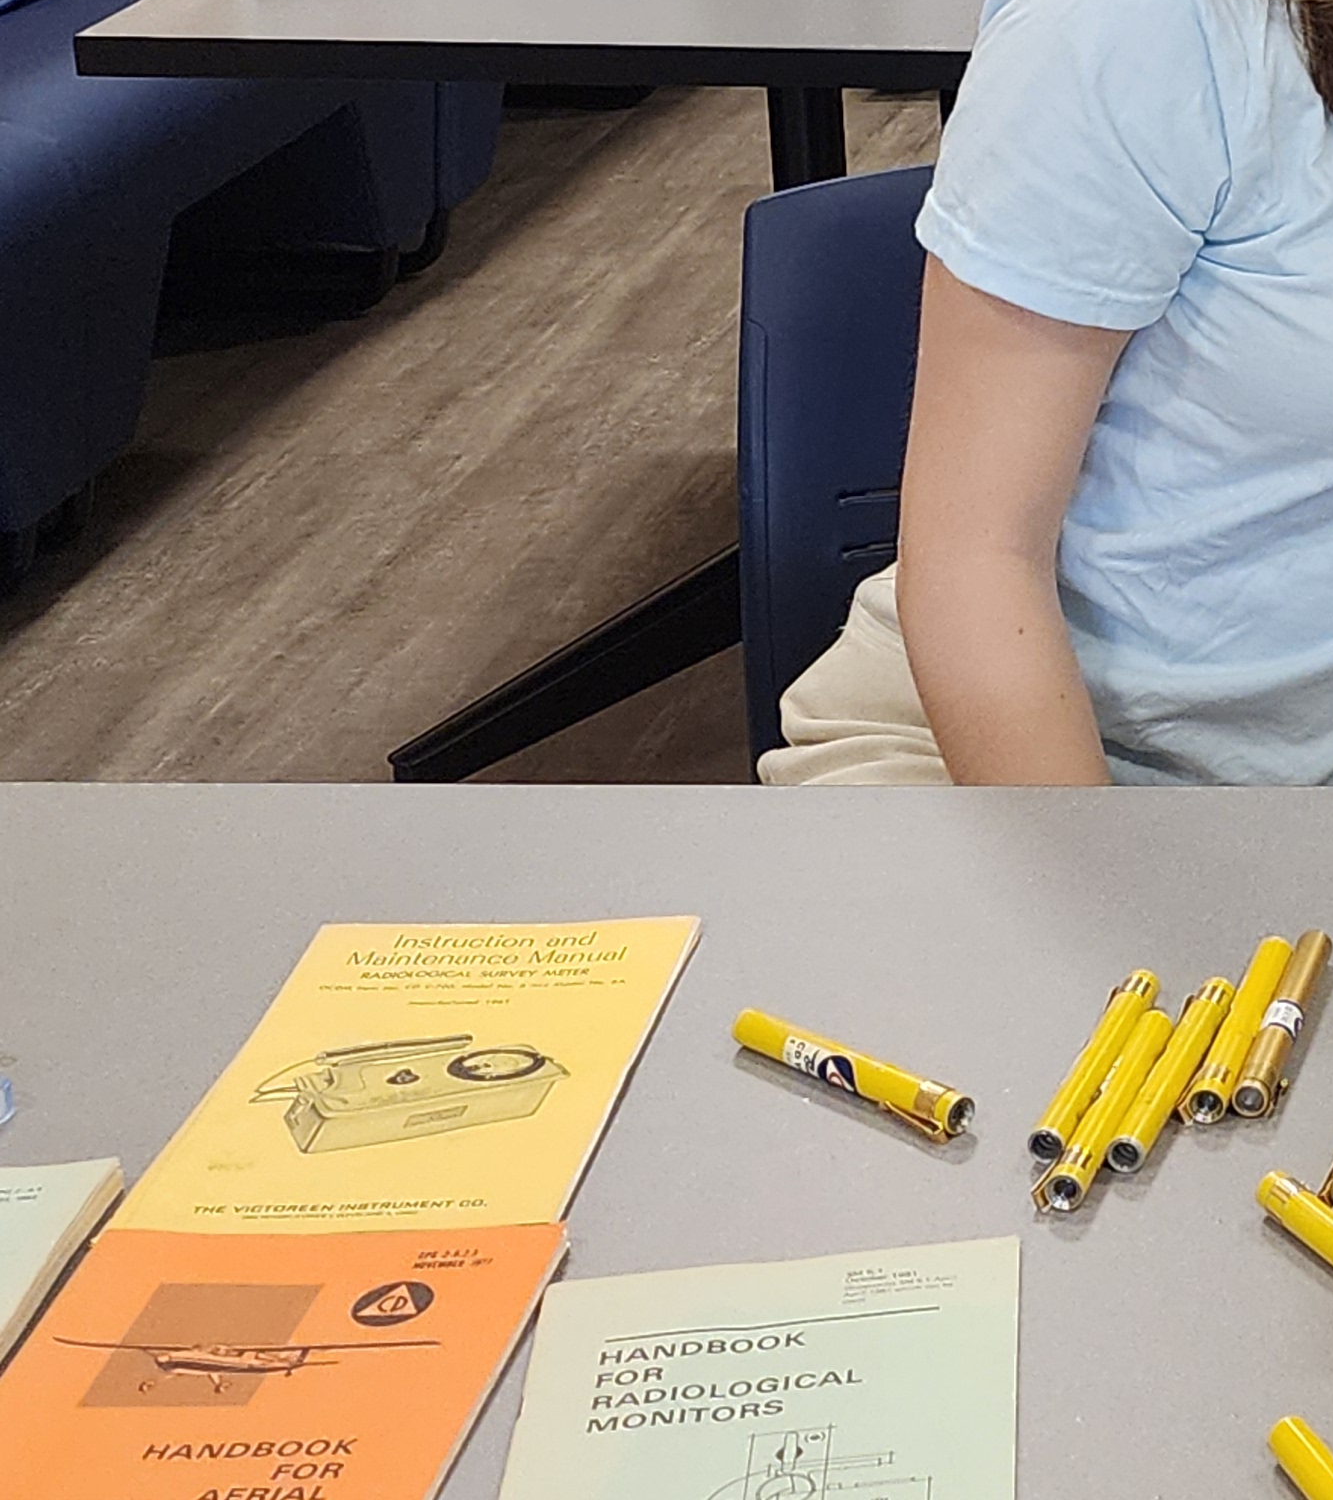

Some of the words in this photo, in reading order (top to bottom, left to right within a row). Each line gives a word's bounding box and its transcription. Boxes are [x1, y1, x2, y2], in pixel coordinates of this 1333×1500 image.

[393, 933, 535, 949] Instruction
[545, 930, 598, 947] and
[346, 946, 519, 967] Maintenance
[523, 946, 628, 964] Manual
[359, 970, 472, 980] RADIOLOGICAL
[479, 969, 538, 978] SURVEY
[542, 966, 591, 976] METER
[193, 1205, 227, 1216] THE
[232, 1202, 336, 1214] VICTOREEN
[337, 1198, 455, 1212] INSTRUMENT
[376, 1294, 409, 1314] CD
[598, 1331, 808, 1367] HANDBOOK
[594, 1365, 665, 1390] FOR
[591, 1367, 864, 1412] RADIOLOGICAL
[585, 1399, 785, 1435] MONITORS
[141, 1437, 359, 1461] HANDBOOK
[270, 1462, 345, 1481] FOR
[195, 1484, 328, 1500] AERIAL
